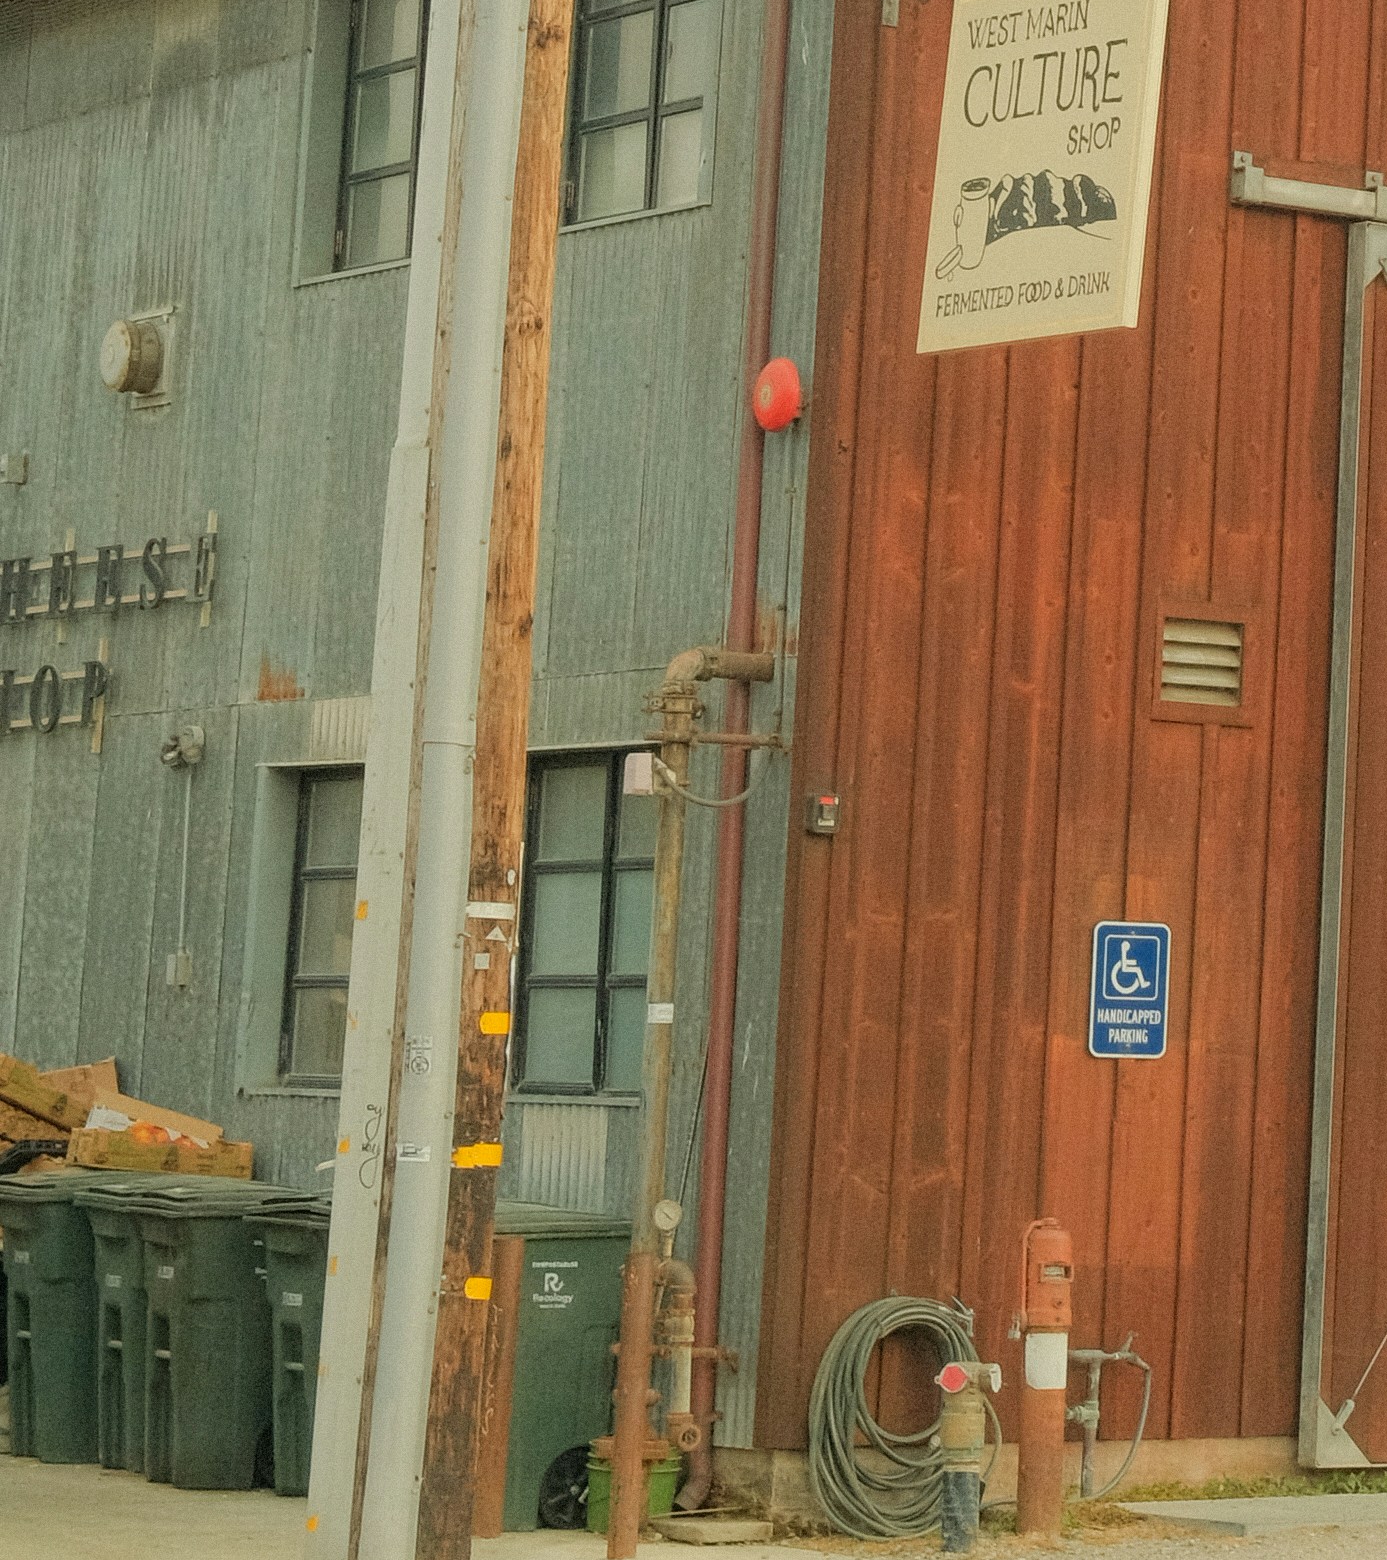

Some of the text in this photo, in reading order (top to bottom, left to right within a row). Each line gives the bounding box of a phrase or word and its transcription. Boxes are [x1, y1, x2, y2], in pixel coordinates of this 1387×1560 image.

[968, 11, 1023, 49] WEST
[964, 38, 1128, 127] CULTURE
[1067, 117, 1121, 155] SHOP
[936, 271, 1111, 317] FERMENTED FOOD & DRINK
[1097, 1008, 1161, 1025] HANDICAPPED
[1109, 1028, 1149, 1044] PARKING
